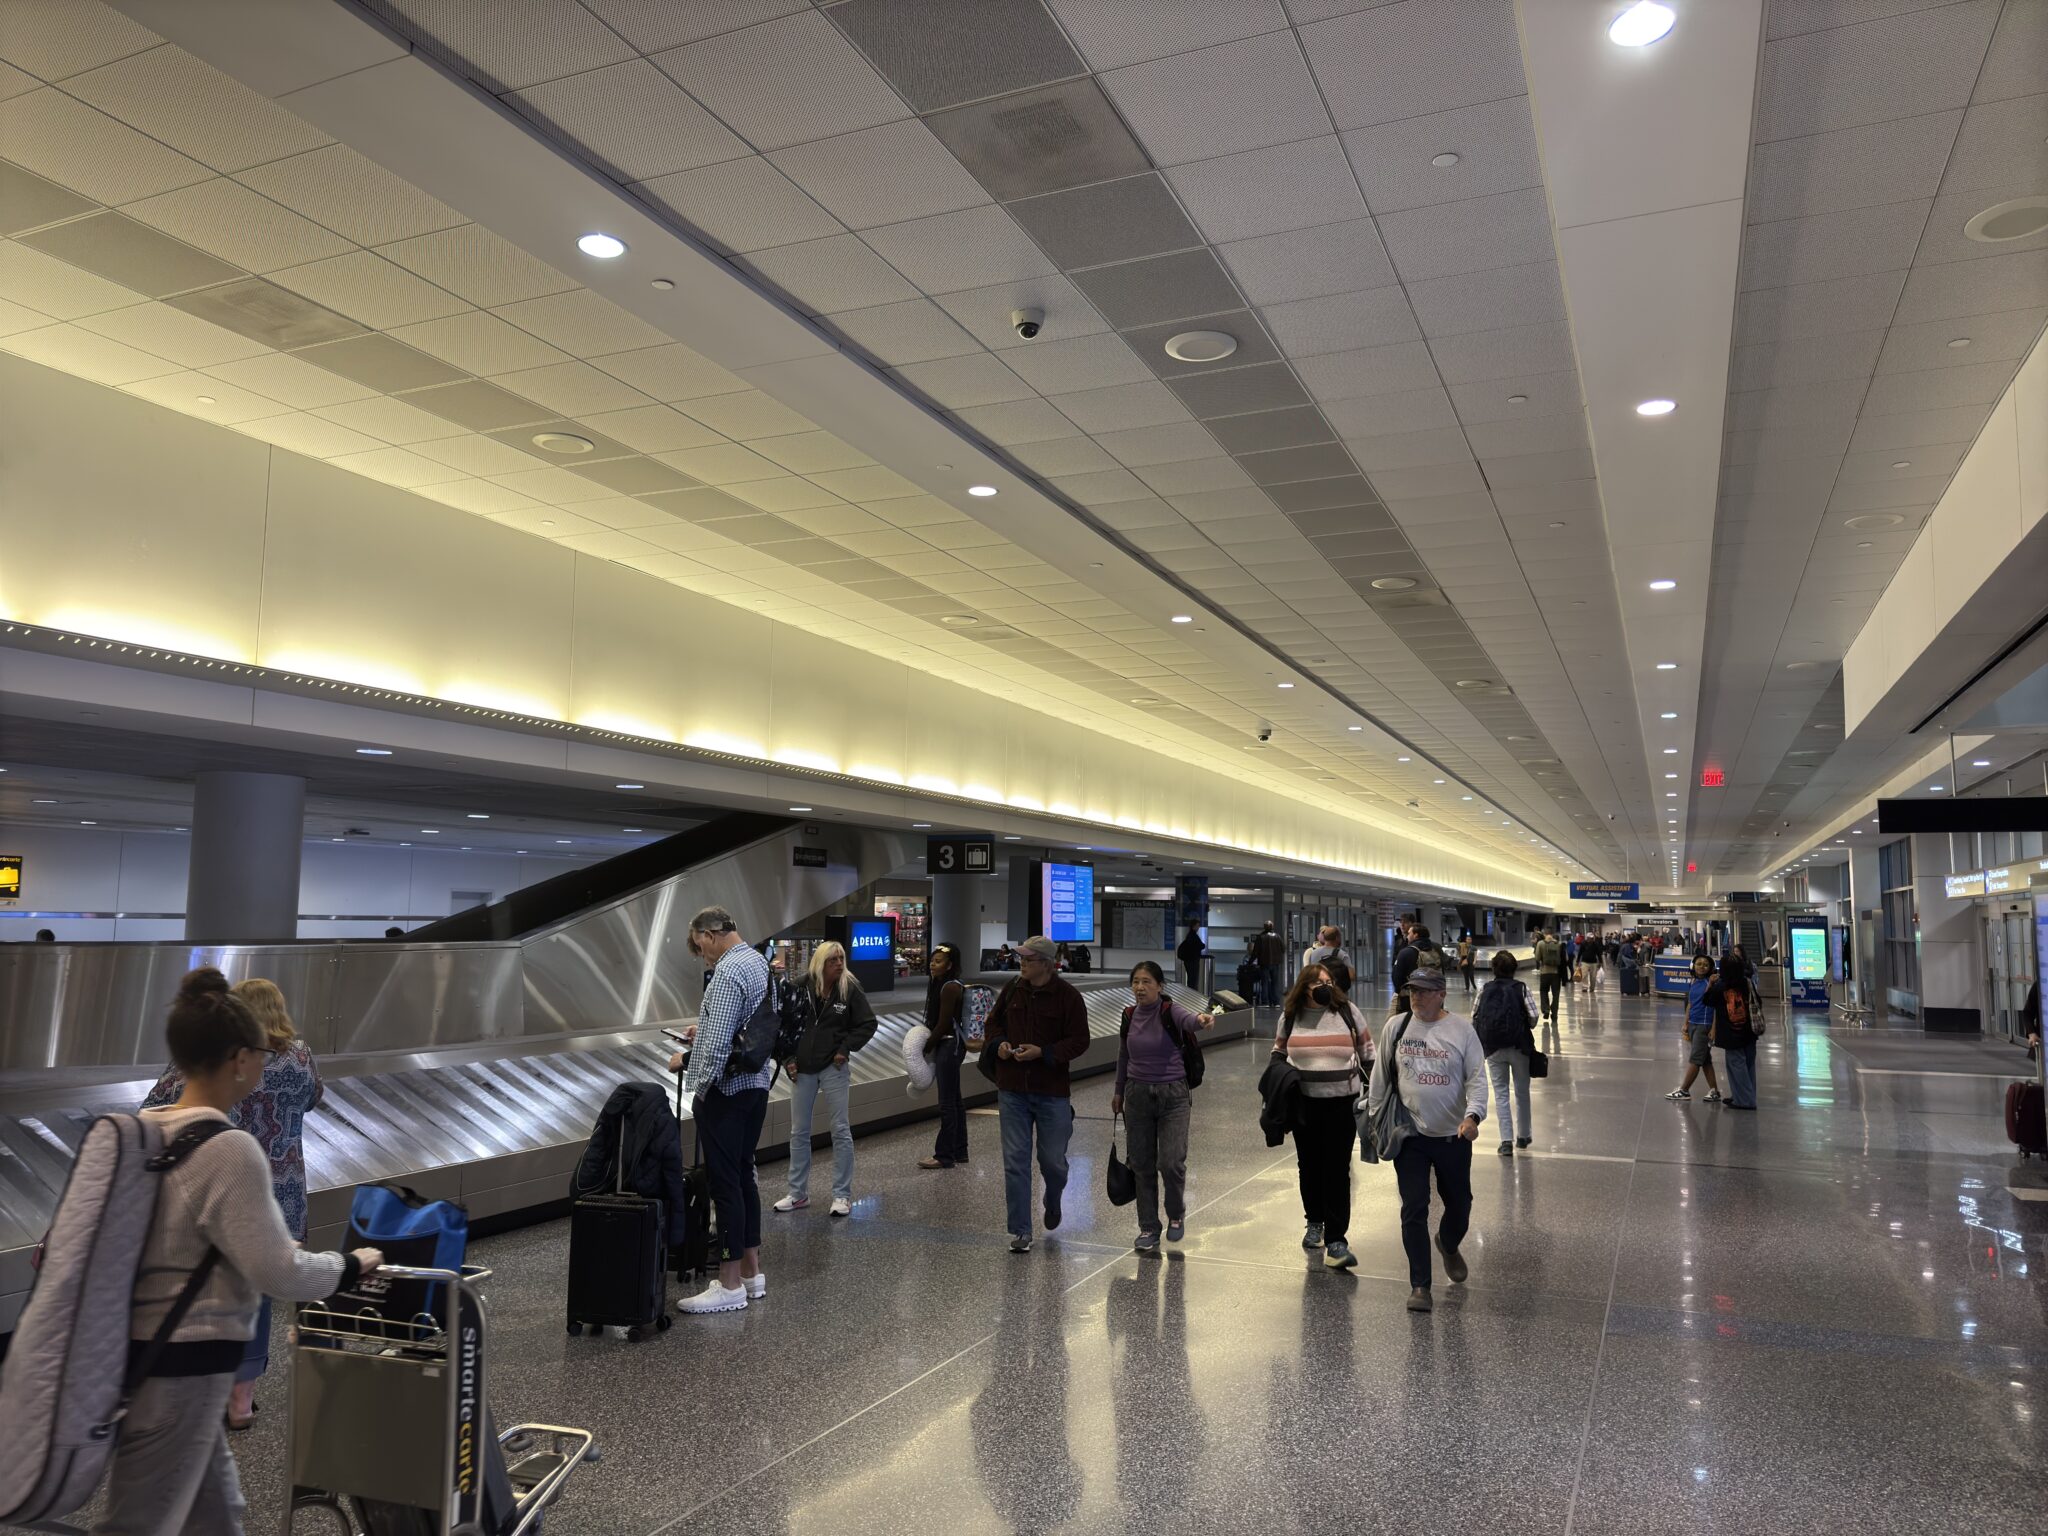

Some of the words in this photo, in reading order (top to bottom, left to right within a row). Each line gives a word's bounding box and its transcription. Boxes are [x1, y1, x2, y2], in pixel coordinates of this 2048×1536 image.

[939, 845, 954, 869] 3
[859, 936, 884, 946] DELTA
[1400, 1039, 1427, 1049] LAMPSON
[1399, 1046, 1421, 1056] CABLE
[1423, 1049, 1449, 1059] BRIDGE
[1418, 1073, 1451, 1086] 2009
